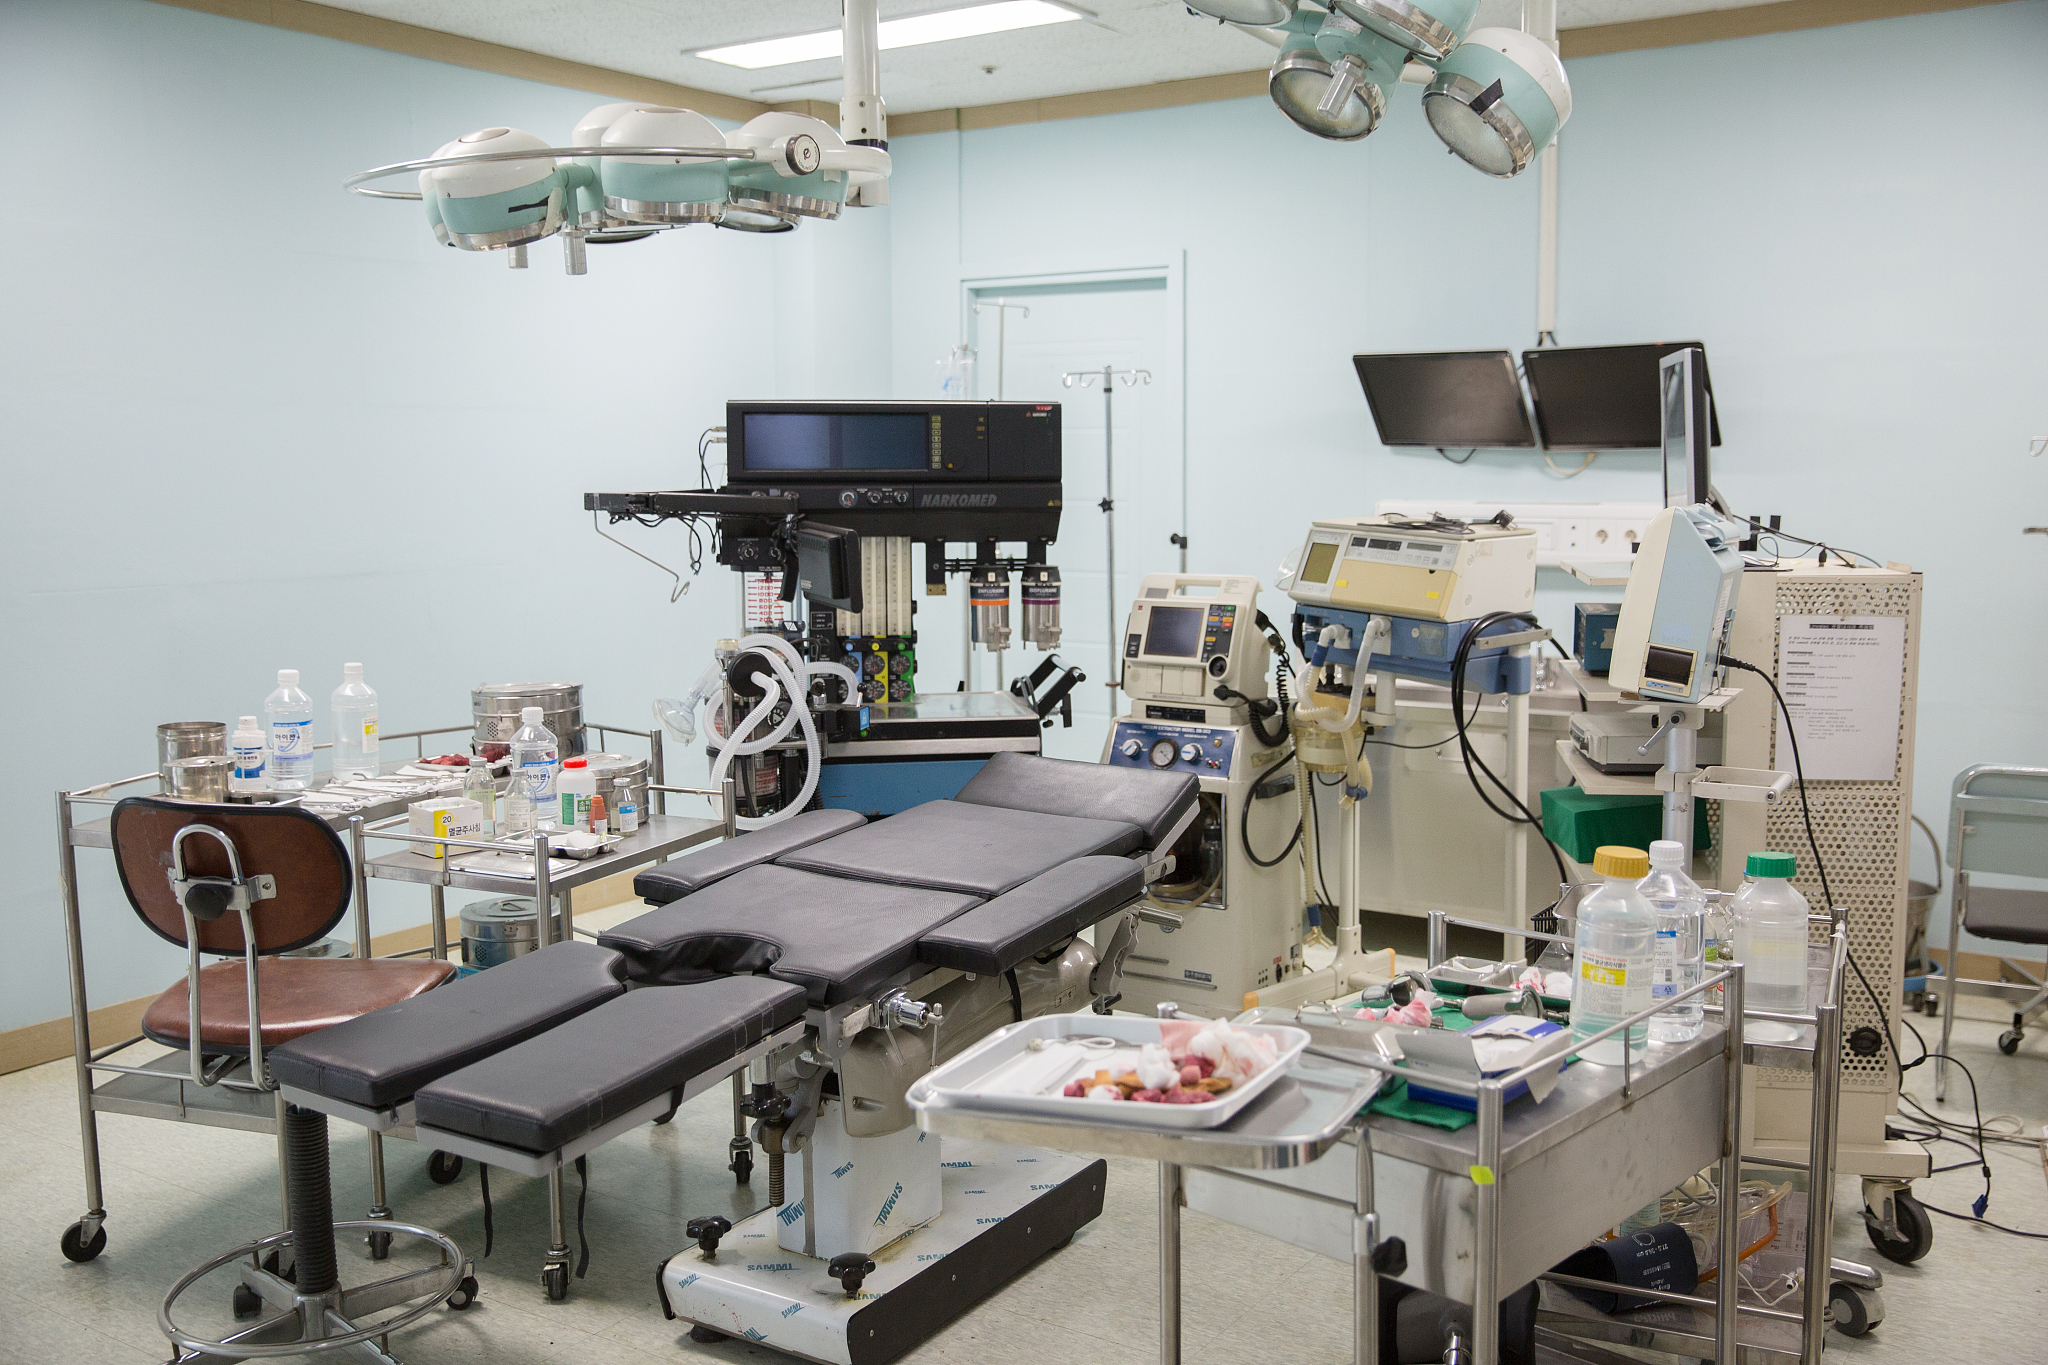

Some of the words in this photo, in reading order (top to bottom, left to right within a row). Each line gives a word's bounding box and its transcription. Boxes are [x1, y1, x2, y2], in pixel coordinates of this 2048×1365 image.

[921, 494, 997, 507] NARKOMED
[442, 815, 452, 824] 20
[448, 823, 481, 837] 멸균주사침
[831, 1161, 854, 1179] SAMMI
[873, 1182, 903, 1226] SAMMI
[777, 1197, 805, 1227] AMMI
[976, 1217, 1007, 1225] SAM
[917, 1253, 949, 1262] SAM
[747, 1263, 799, 1272] SAMMI
[679, 1273, 700, 1289] SAMMI
[781, 1302, 804, 1319] SAMMI
